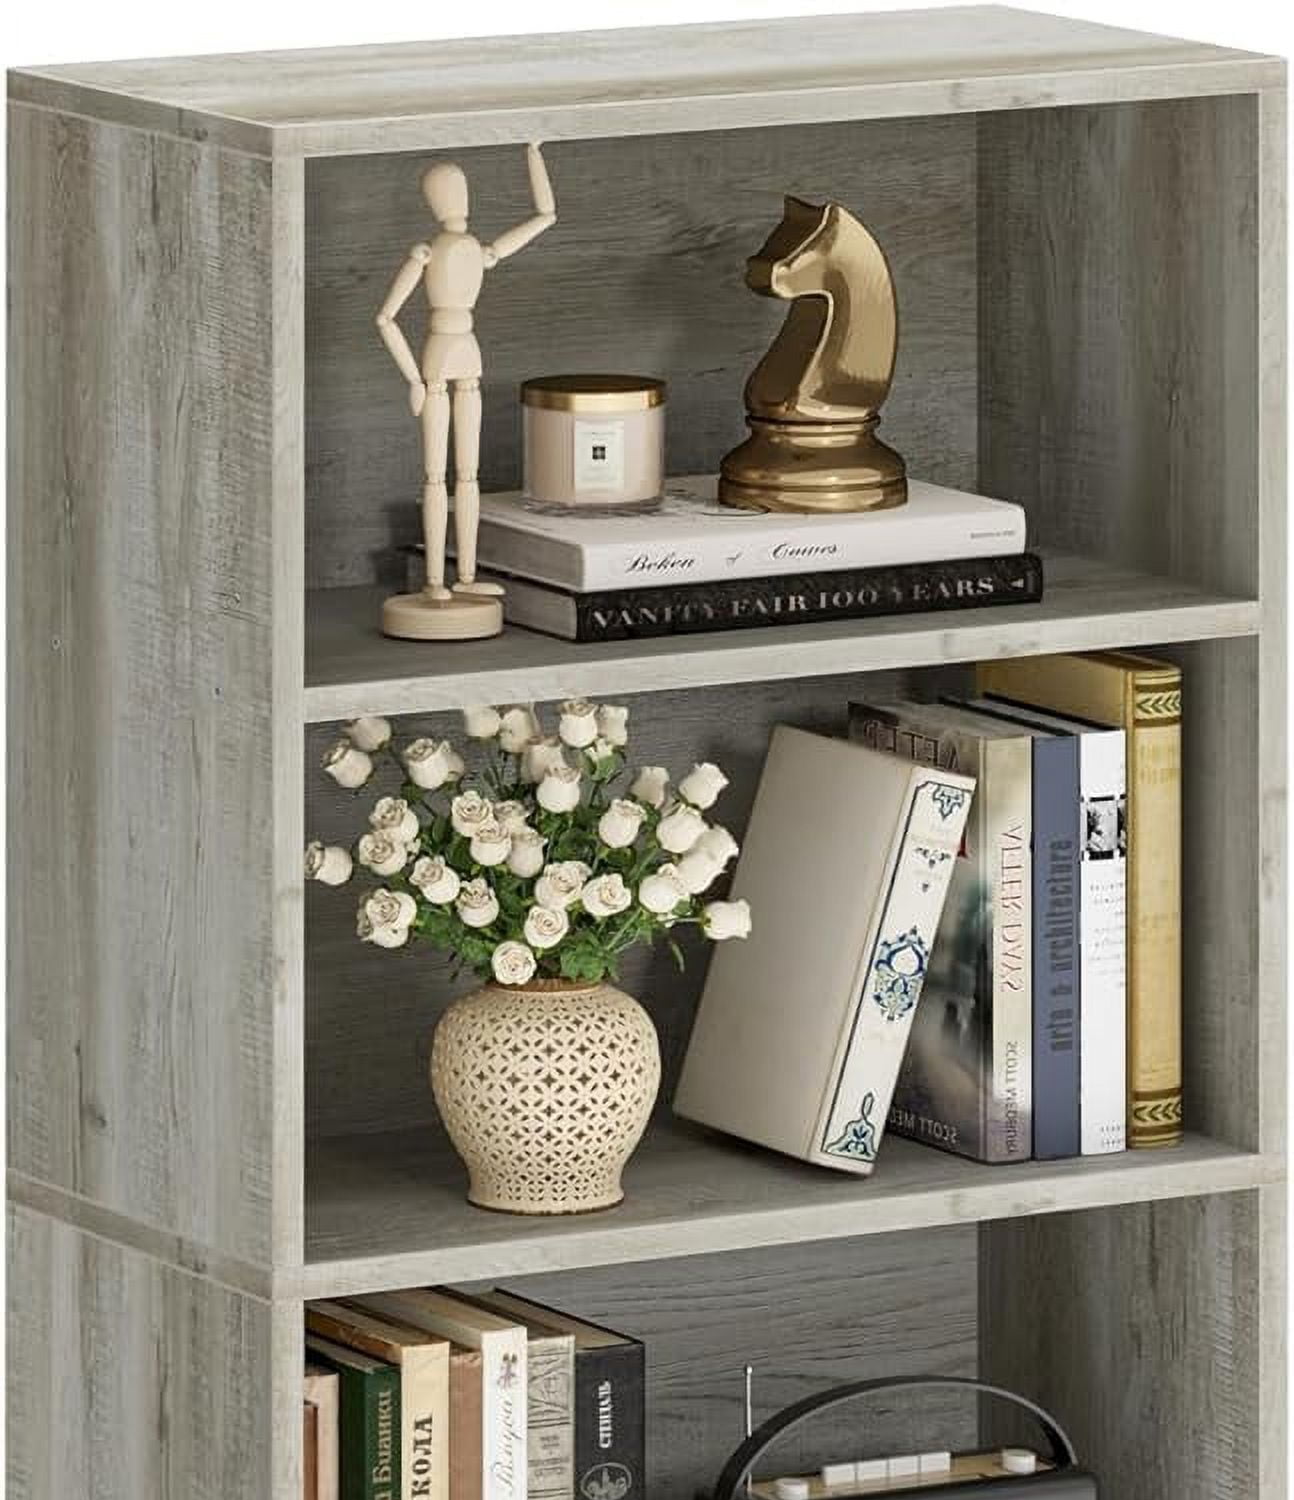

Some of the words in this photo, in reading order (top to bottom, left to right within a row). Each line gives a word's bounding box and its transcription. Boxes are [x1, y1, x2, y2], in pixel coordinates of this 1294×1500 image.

[625, 552, 695, 573] Beken
[592, 604, 716, 628] VANITY
[732, 595, 808, 617] FAIR
[890, 576, 995, 603] YEARS
[1044, 840, 1073, 972] architecture
[372, 1390, 392, 1485] Бианки
